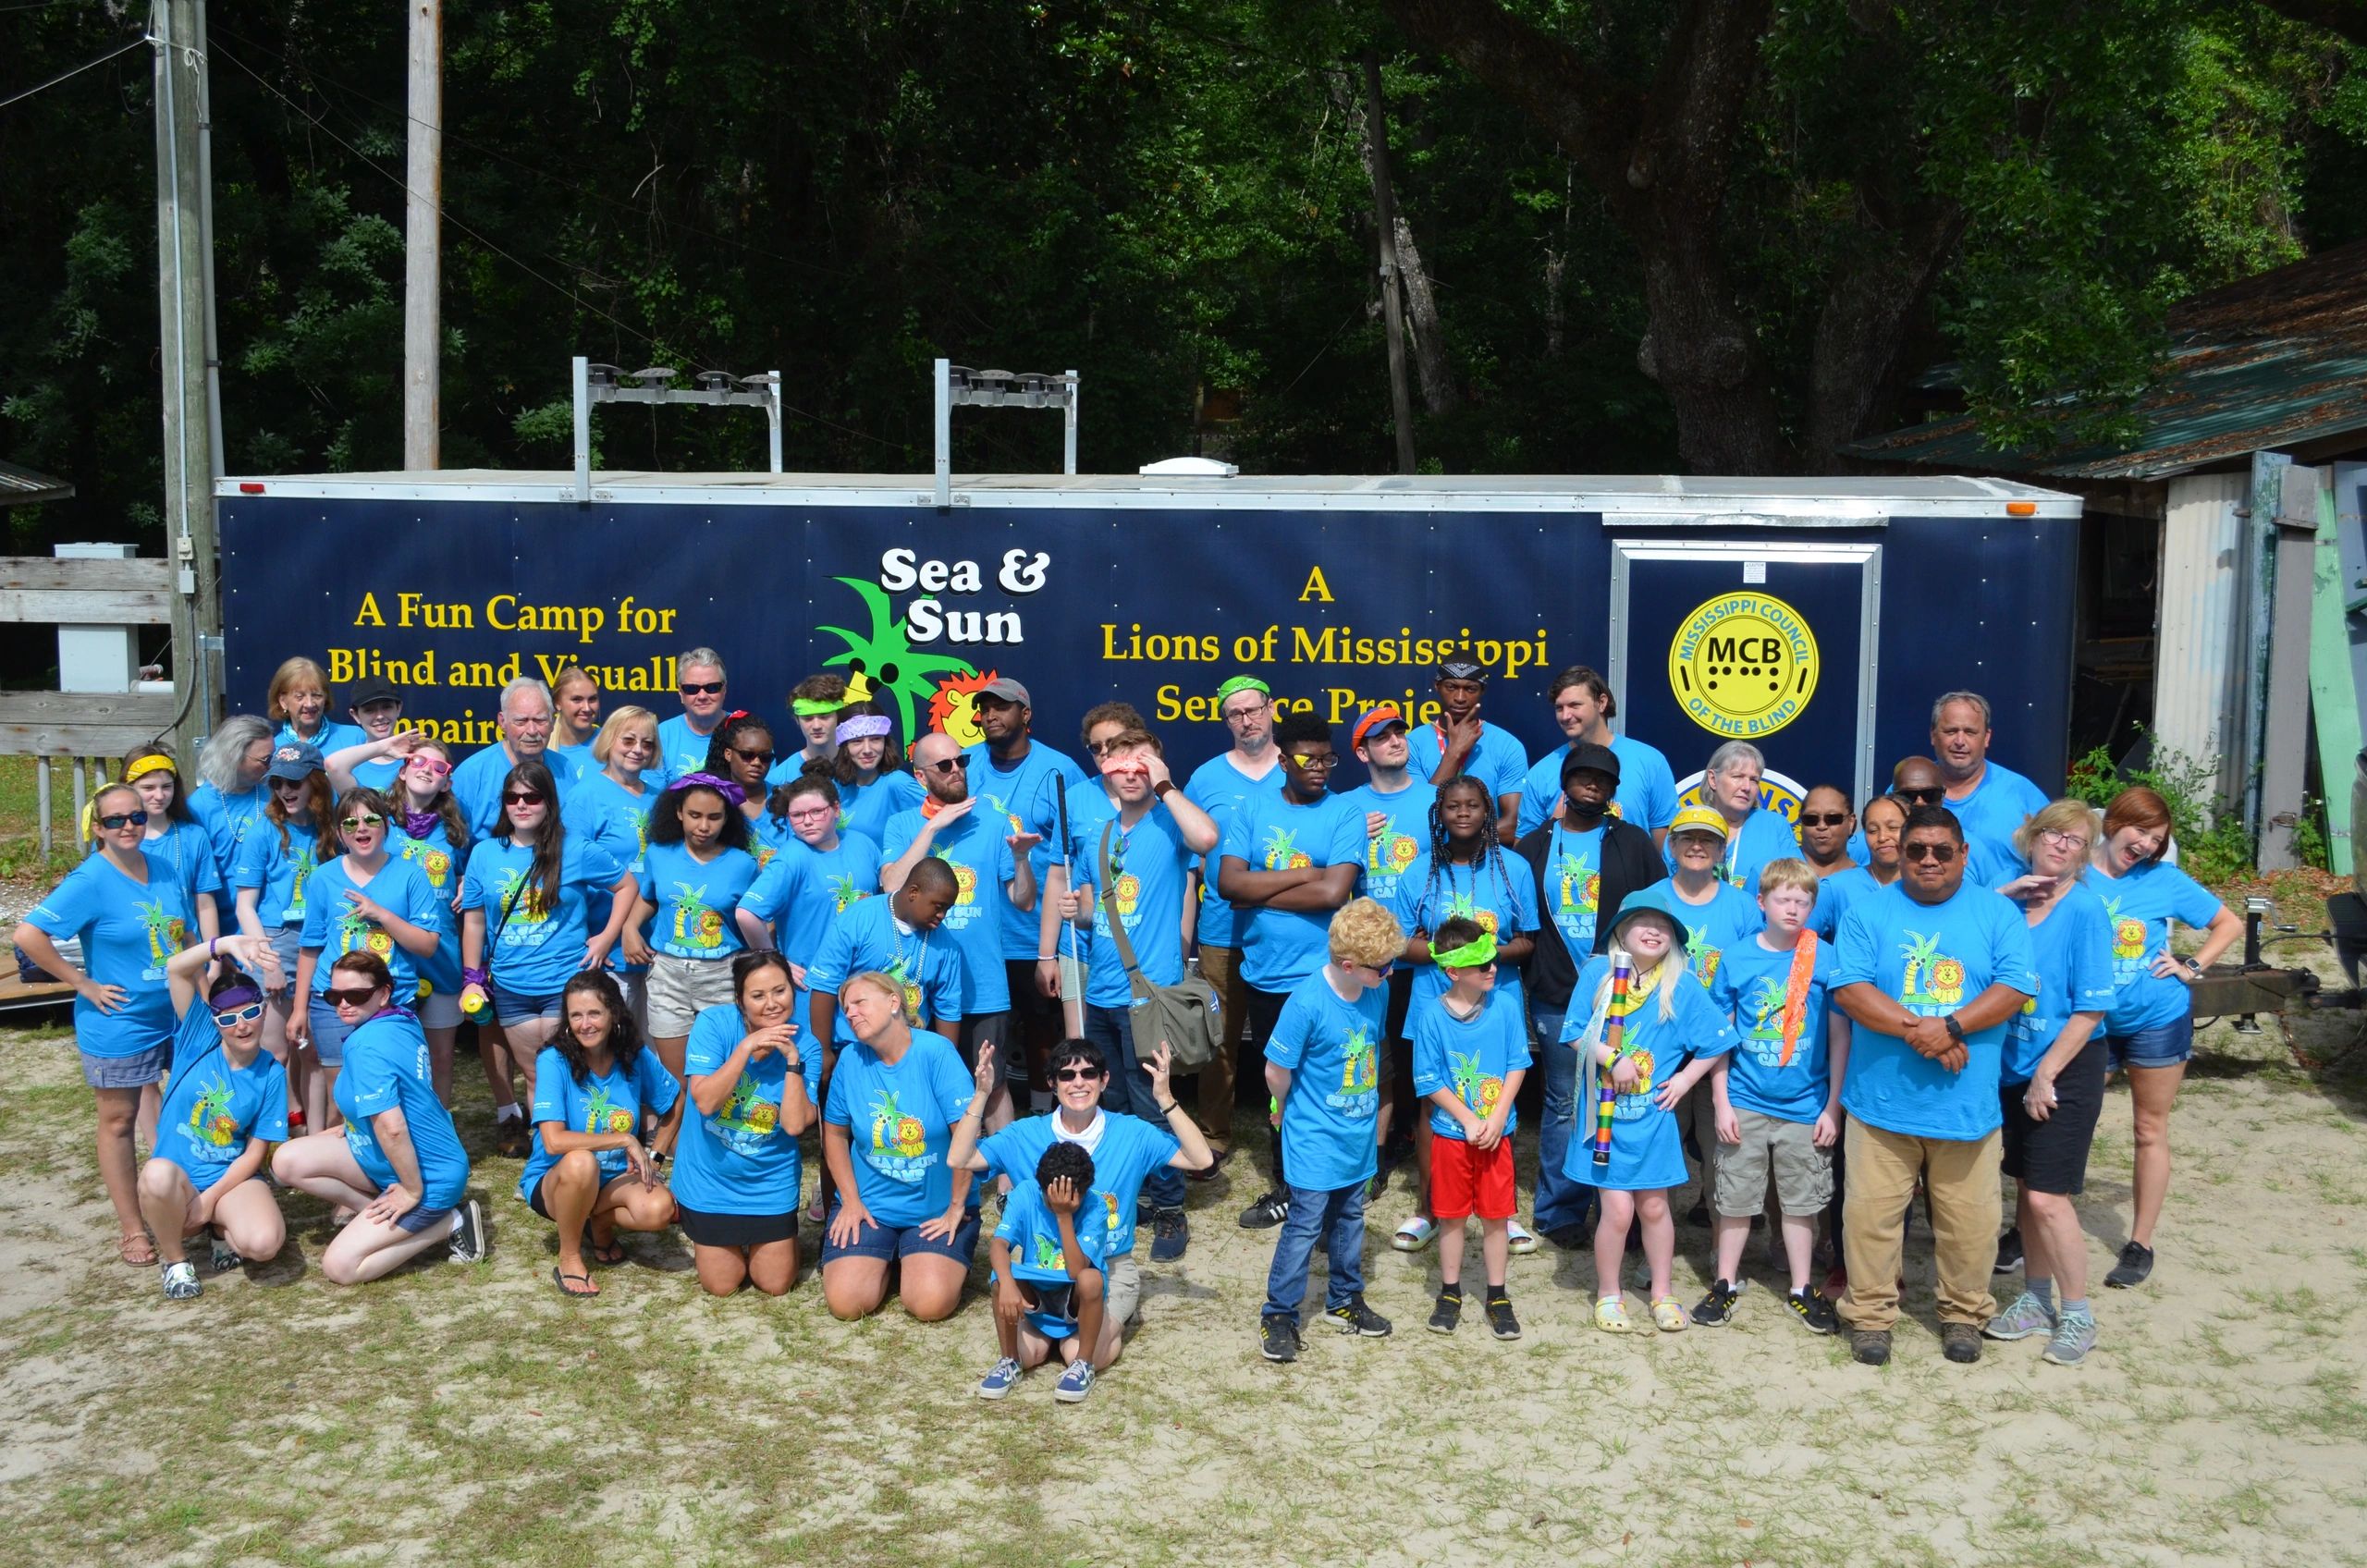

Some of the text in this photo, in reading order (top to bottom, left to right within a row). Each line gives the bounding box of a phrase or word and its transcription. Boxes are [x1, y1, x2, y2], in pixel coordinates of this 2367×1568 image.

[880, 547, 1050, 594] Sea &
[1299, 566, 1335, 602] A
[352, 592, 677, 643] A Fun Camp for
[907, 599, 1024, 644] Sun
[1679, 600, 1809, 666] MISSISSIPPI COUNCIL
[1100, 623, 1220, 662] Lions
[1233, 624, 1280, 663] of
[1707, 637, 1782, 664] MCB
[327, 648, 681, 693] Blind and Vsuall
[1156, 684, 1315, 724] Serce
[1688, 698, 1797, 733] OF THE BLIND
[941, 917, 969, 930] AMP
[1567, 925, 1596, 939] CAM
[1757, 1052, 1802, 1068] CAP
[1612, 1105, 1647, 1121] AMP
